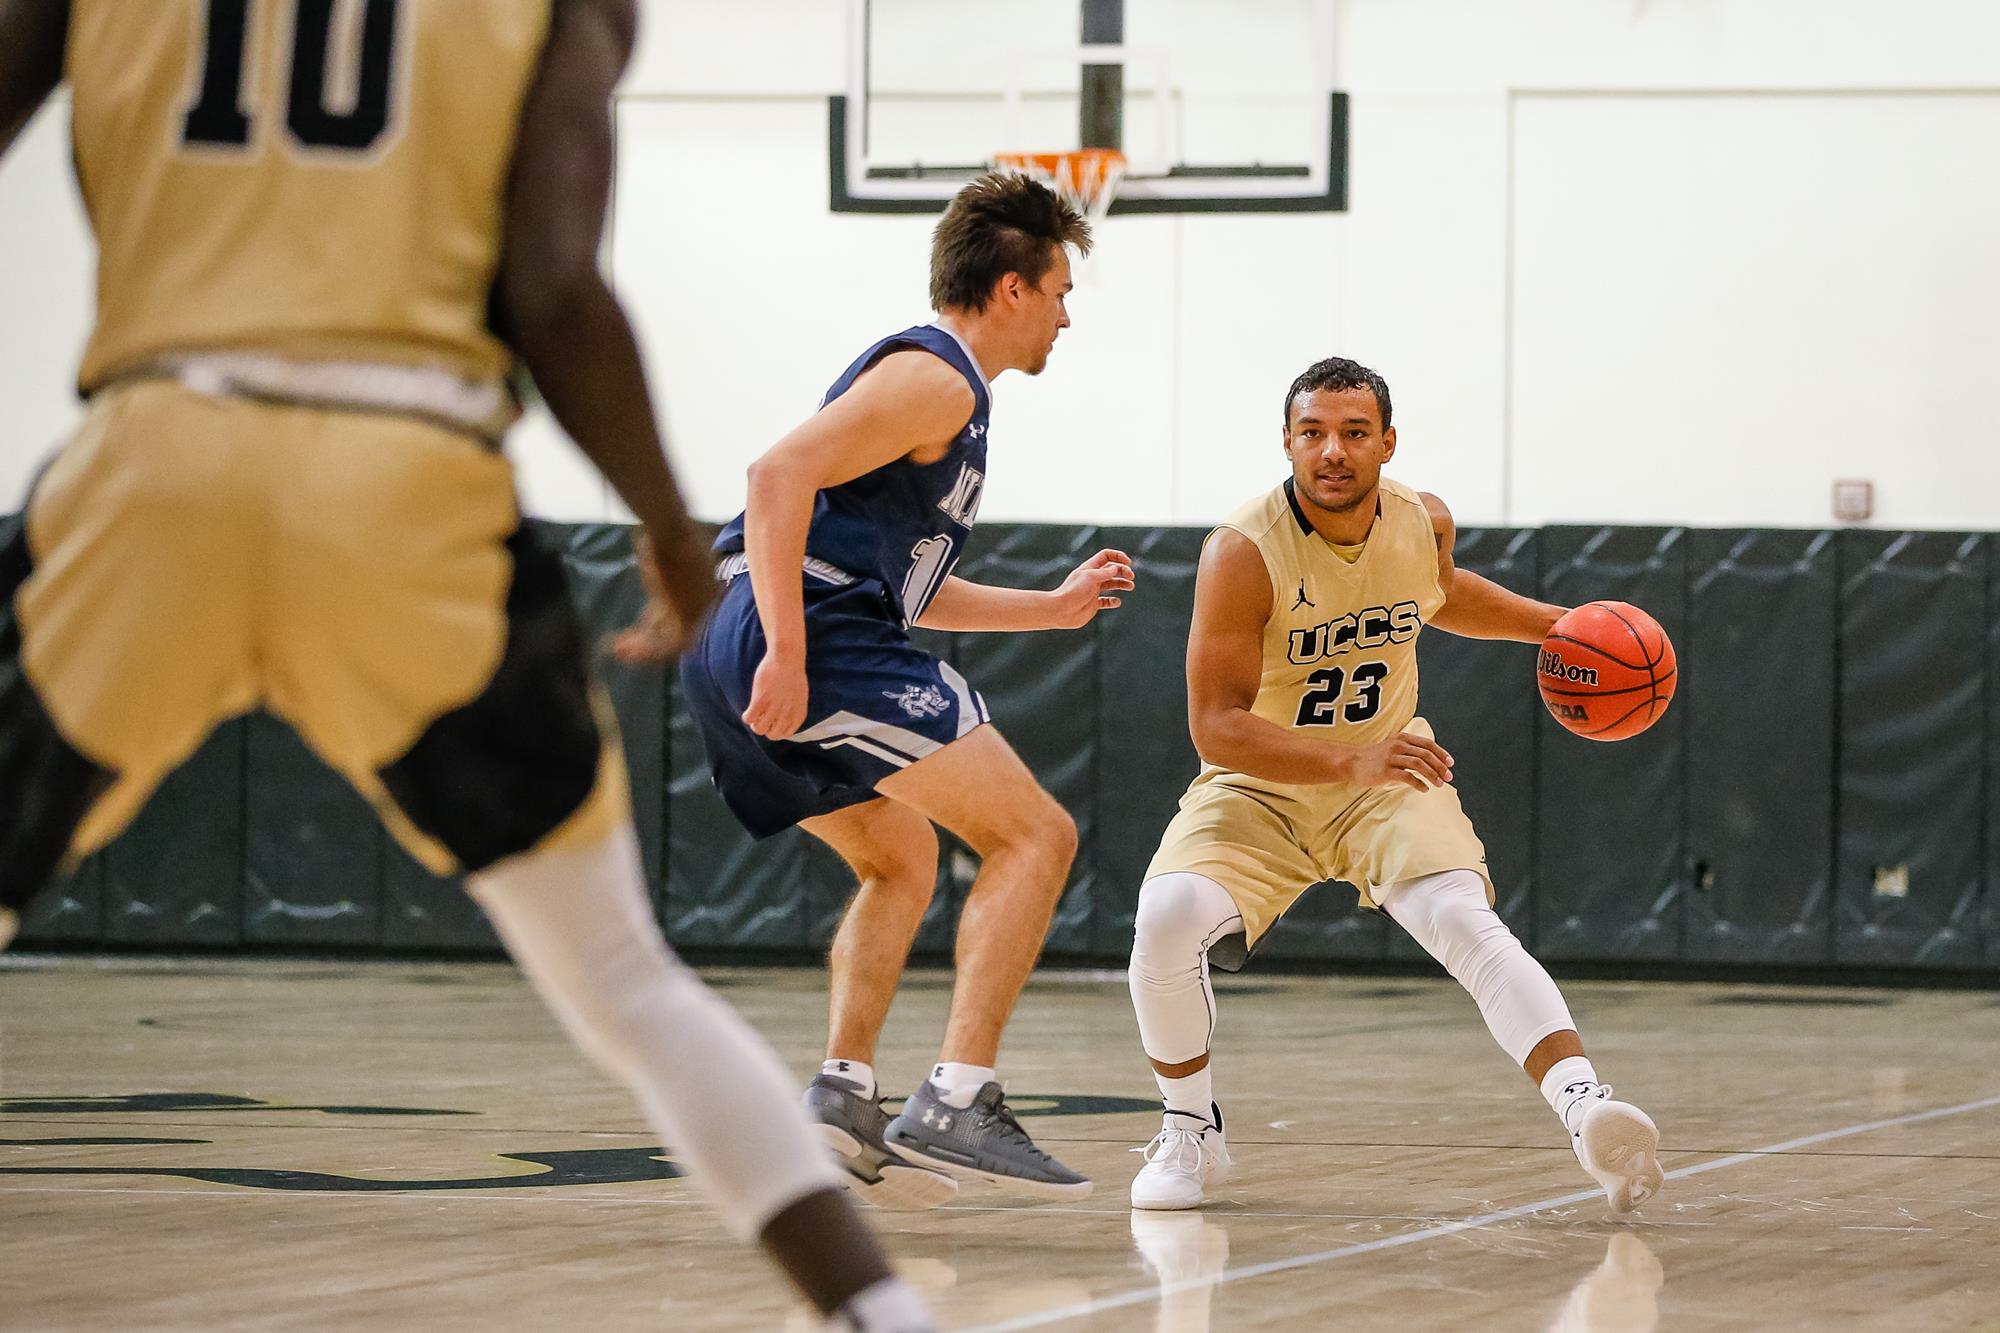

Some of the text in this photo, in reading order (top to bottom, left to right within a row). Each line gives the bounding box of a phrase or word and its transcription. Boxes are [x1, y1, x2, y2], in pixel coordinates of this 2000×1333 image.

[1287, 600, 1422, 664] UCCS
[1292, 660, 1390, 728] 23
[1547, 700, 1590, 721] CAA
